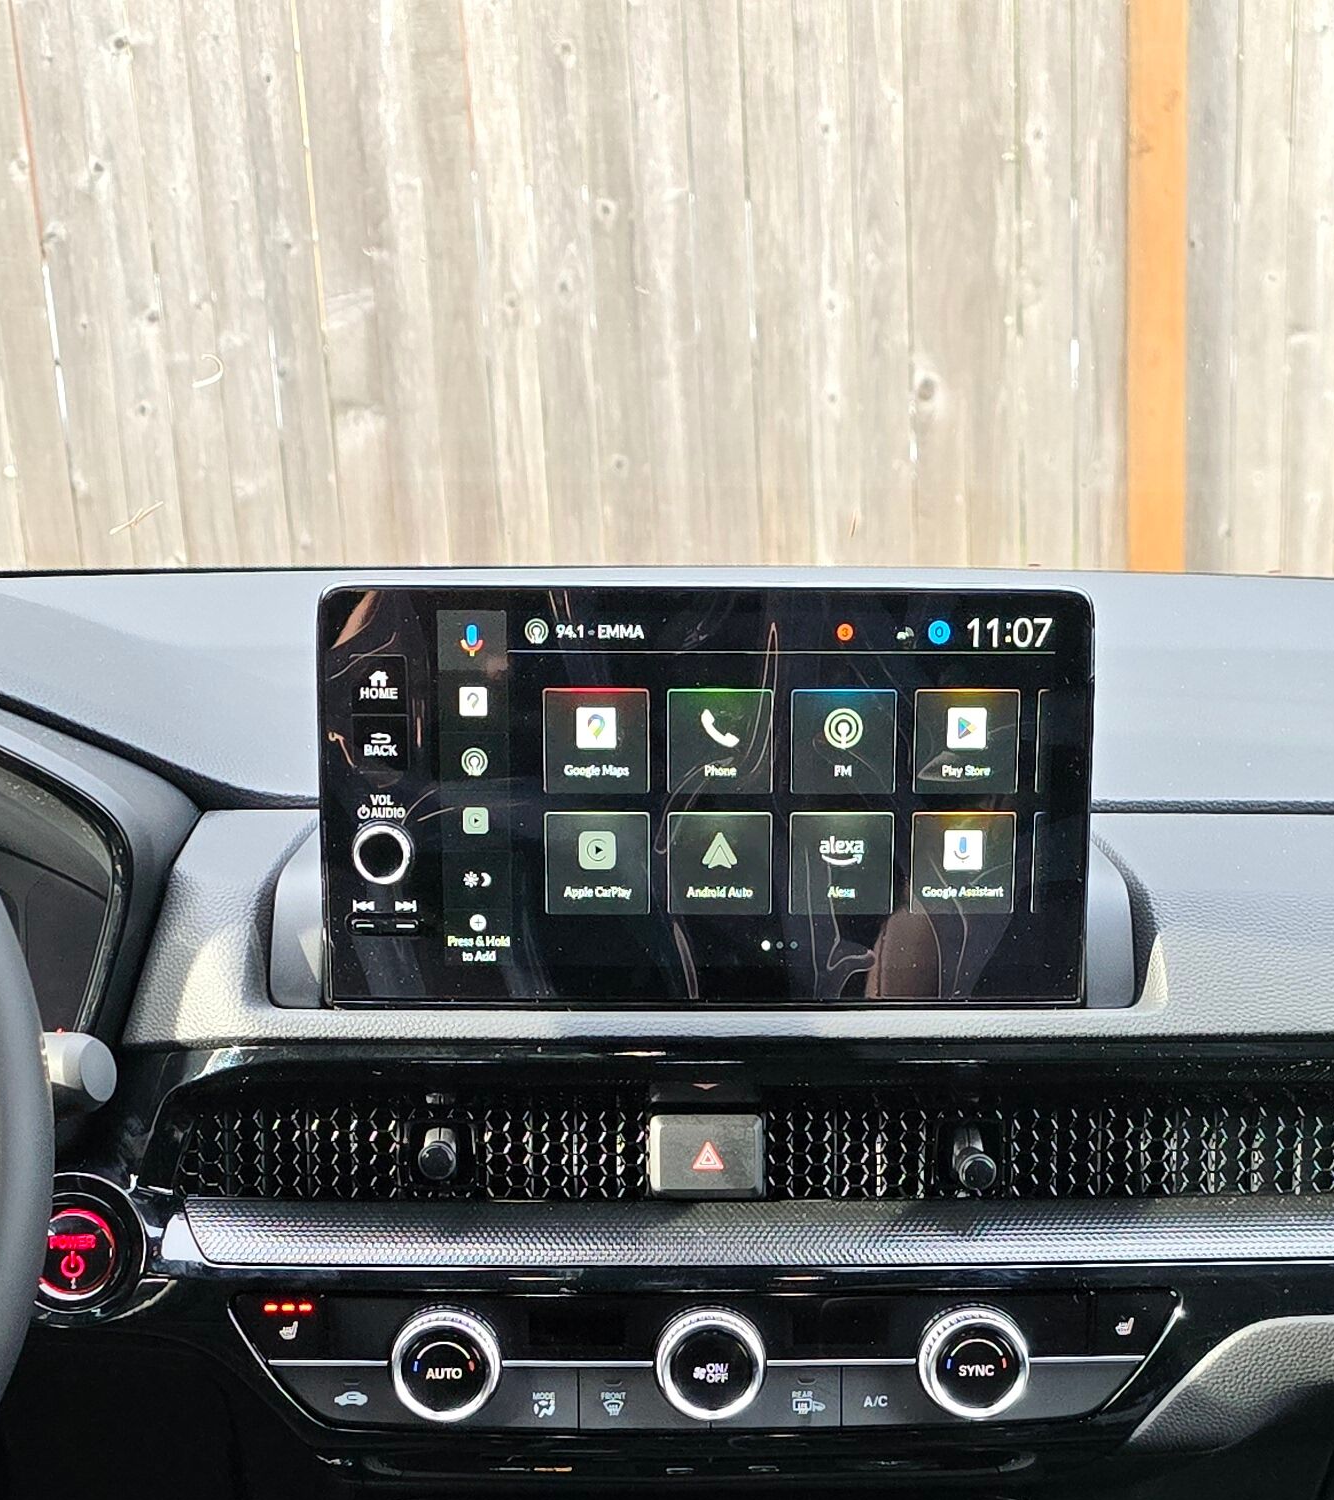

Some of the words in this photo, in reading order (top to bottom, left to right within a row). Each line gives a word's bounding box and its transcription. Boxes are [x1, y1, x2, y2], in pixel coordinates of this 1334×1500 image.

[555, 624, 585, 639] 94.1
[597, 624, 645, 639] EMMA
[967, 617, 1053, 648] 11:07
[359, 687, 399, 700] HOME
[363, 744, 399, 757] BACK
[563, 765, 600, 779] Google
[601, 765, 630, 778] Maps
[704, 765, 737, 777] Phone
[833, 765, 853, 777] FM
[941, 765, 963, 778] Play
[964, 765, 992, 777] Store
[369, 794, 395, 806] VOL
[370, 807, 407, 819] AUDIO
[819, 836, 865, 855] alexa
[563, 886, 594, 899] Apple
[595, 886, 633, 900] CarPlay
[686, 886, 727, 898] Android
[728, 886, 754, 898] Auto
[827, 886, 856, 898] Alexa
[921, 886, 957, 899] Google
[958, 886, 1004, 898] Assistant
[447, 935, 474, 947] Press
[475, 935, 485, 947] &
[485, 935, 511, 947] Hold
[462, 951, 474, 962] to
[474, 950, 497, 962] Add
[49, 1234, 97, 1250] POWER
[705, 1362, 729, 1373] ON/
[958, 1364, 995, 1378] SYNC
[425, 1367, 463, 1381] AUTO
[706, 1372, 729, 1384] OFF
[532, 1391, 556, 1401] MODE
[600, 1391, 627, 1401] FRONT
[791, 1390, 814, 1399] REAR
[863, 1395, 888, 1409] A/C
